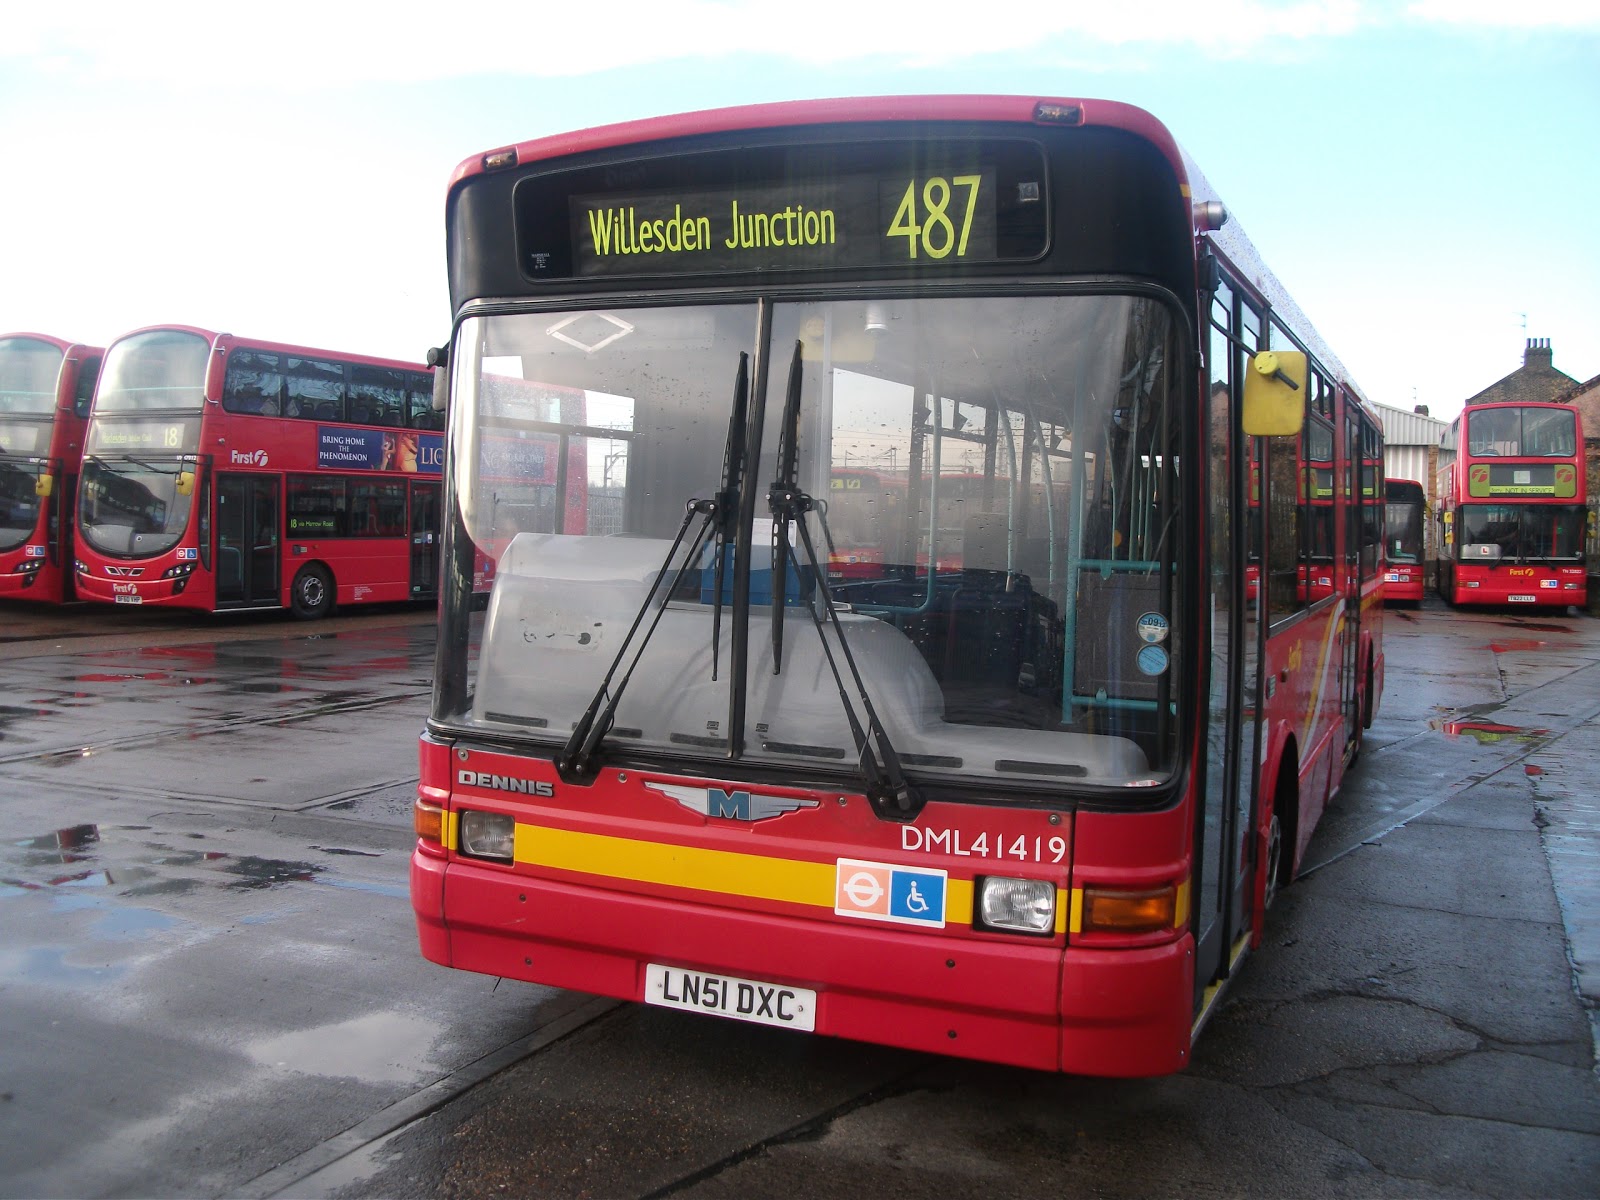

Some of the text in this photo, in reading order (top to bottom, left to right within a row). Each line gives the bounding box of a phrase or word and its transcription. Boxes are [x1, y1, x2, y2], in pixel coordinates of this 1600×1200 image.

[886, 174, 982, 260] 487
[589, 200, 835, 256] Willesden Junction
[164, 427, 178, 447] 18
[322, 435, 365, 446] BRING HOME
[339, 445, 350, 453] THE
[231, 450, 254, 464] First
[319, 451, 368, 462] PHENOMENON
[290, 519, 298, 528] 18
[1509, 568, 1524, 576] First
[113, 583, 128, 593] First
[1148, 617, 1159, 626] 09
[458, 770, 553, 797] DENNIS
[708, 788, 751, 820] M
[902, 825, 1066, 863] DML41419
[663, 970, 795, 1021] LN51 DXC
